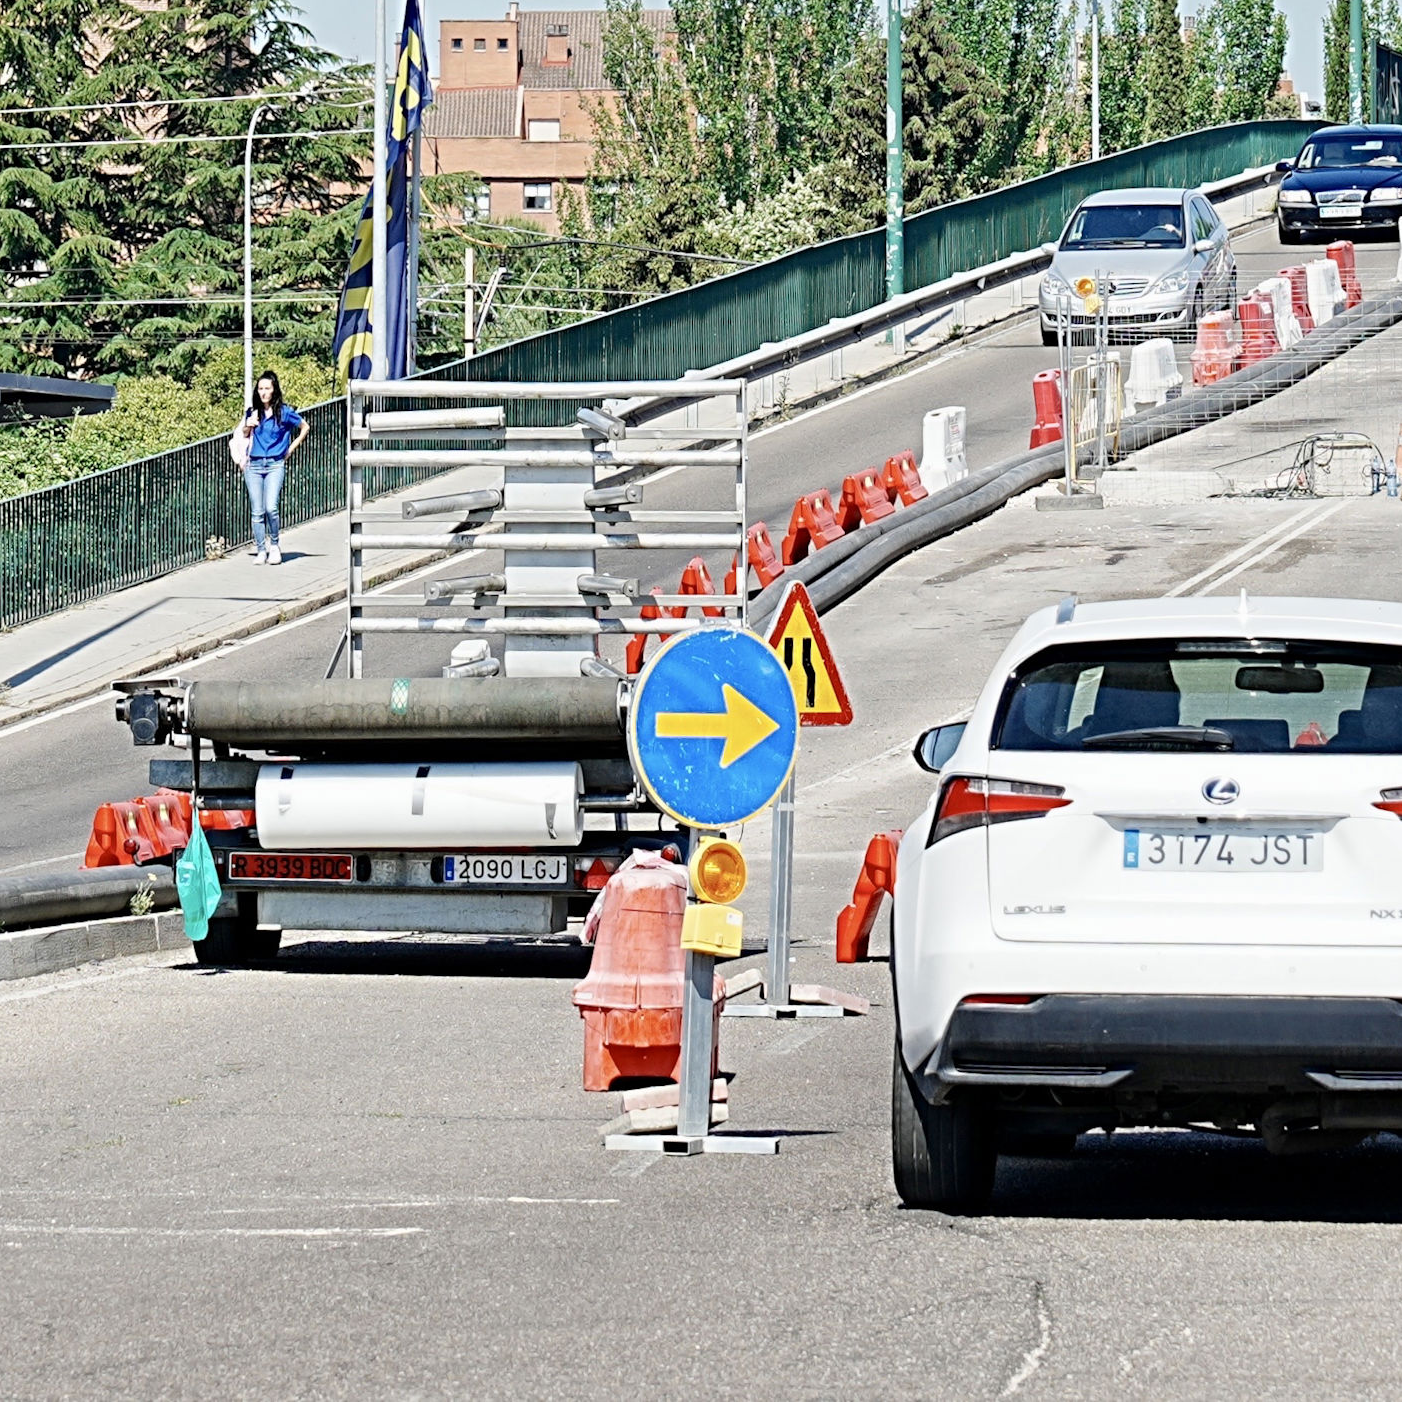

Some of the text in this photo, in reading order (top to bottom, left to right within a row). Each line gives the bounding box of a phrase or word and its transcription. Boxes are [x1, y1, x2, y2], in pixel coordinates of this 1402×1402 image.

[1148, 834, 1234, 865] 3174
[1250, 834, 1314, 865] JST
[236, 856, 248, 877] R
[254, 857, 304, 878] 3939
[459, 859, 512, 879] 2090
[521, 859, 560, 879] LGJ
[1003, 905, 1066, 915] LEXUS
[1369, 909, 1396, 919] NX
